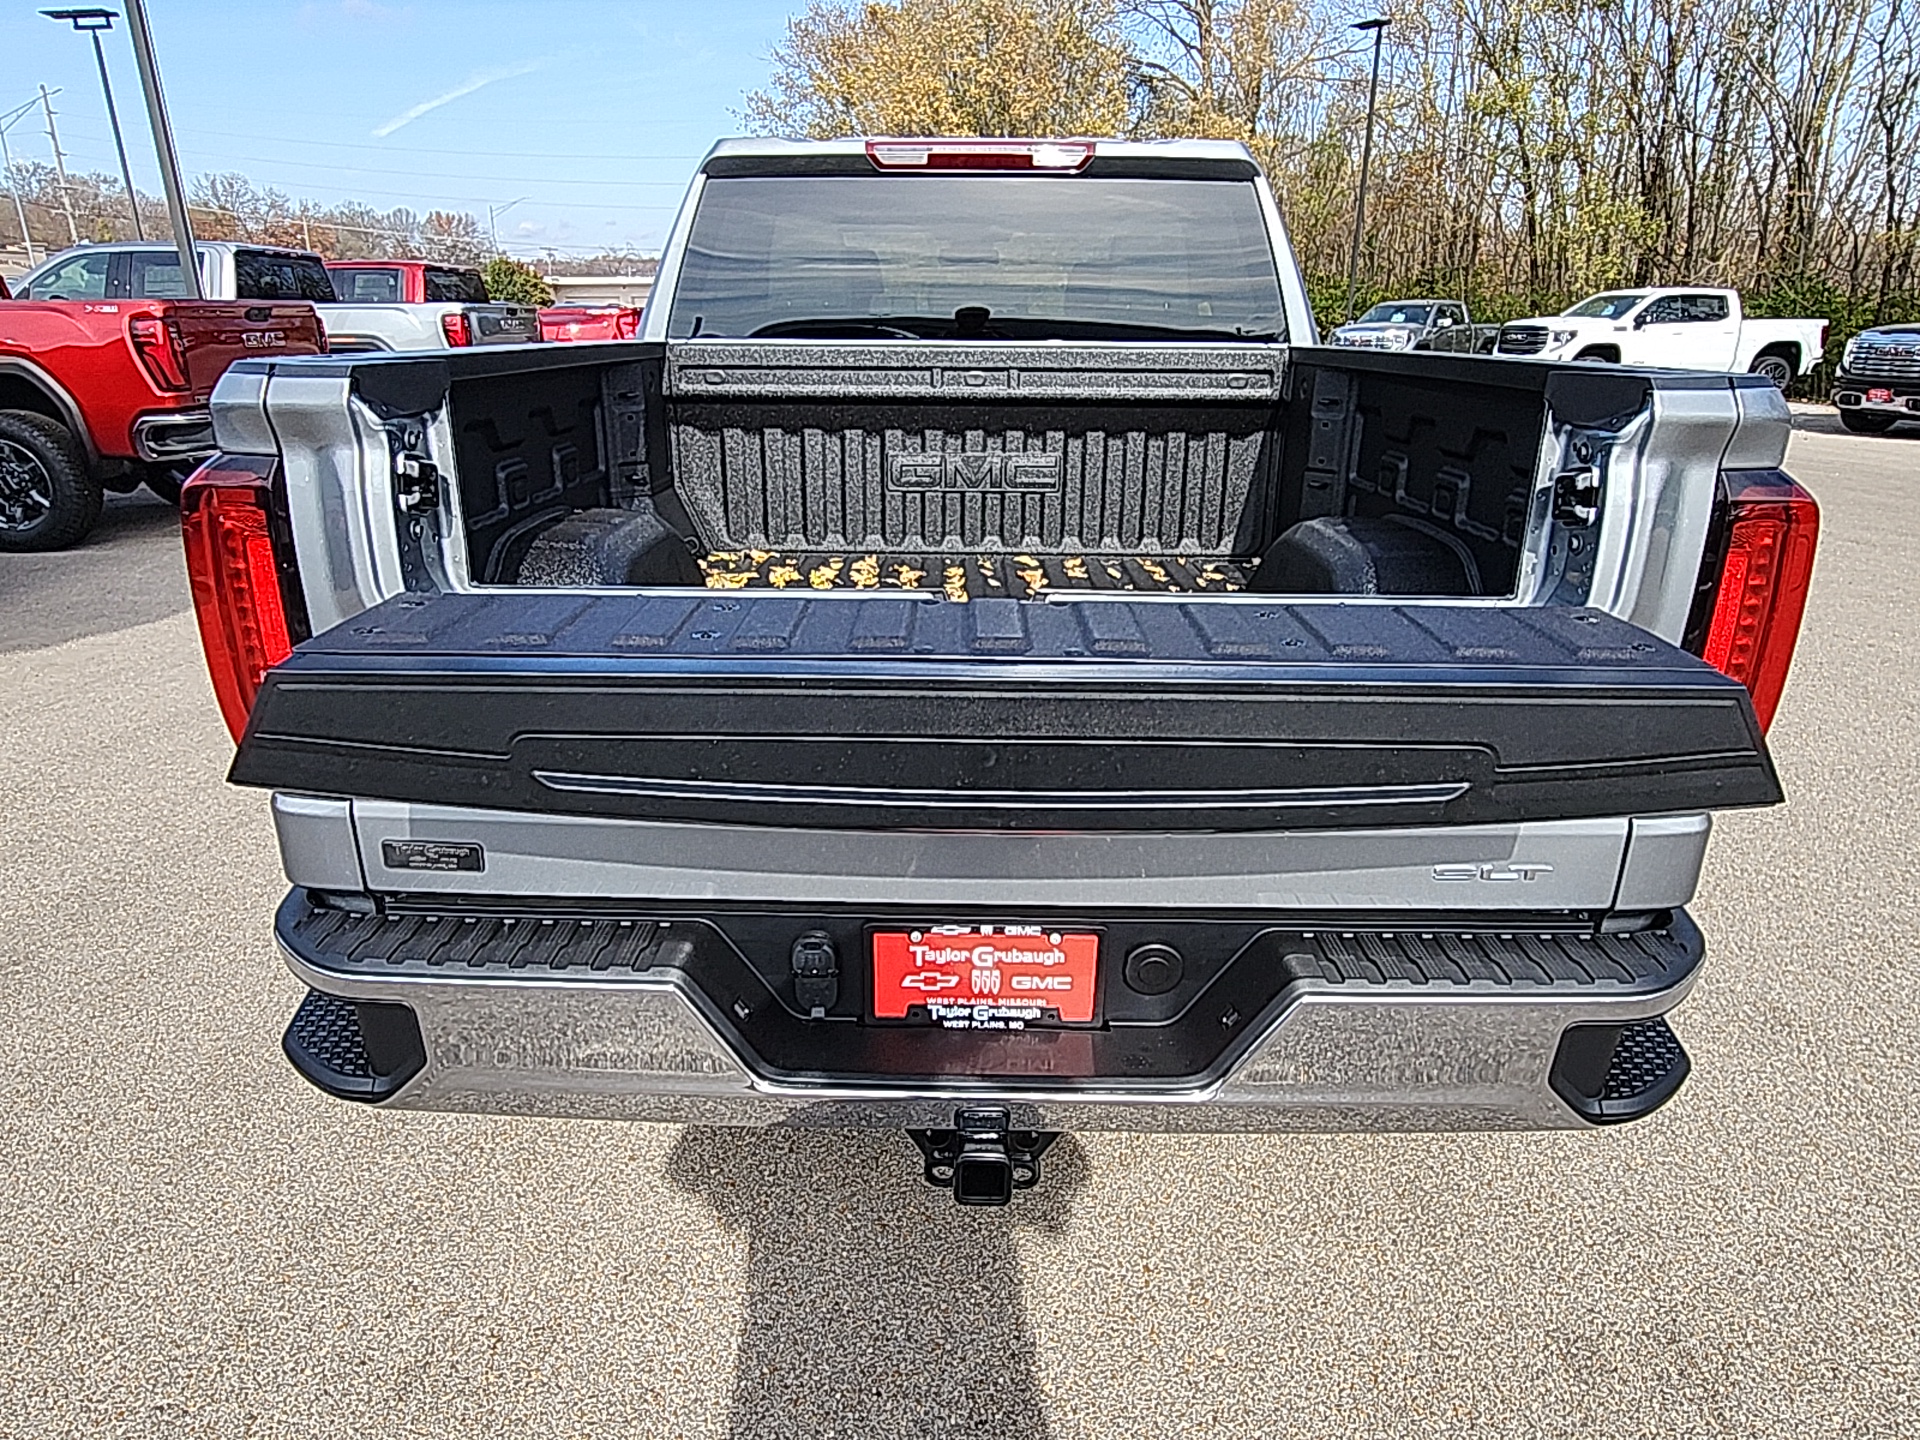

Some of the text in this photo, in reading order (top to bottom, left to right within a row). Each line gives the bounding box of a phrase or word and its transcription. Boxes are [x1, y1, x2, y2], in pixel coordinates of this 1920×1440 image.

[242, 331, 287, 348] GMC
[886, 452, 1062, 492] GMC
[1432, 864, 1554, 881] SLT
[1004, 925, 1042, 936] GMC
[909, 945, 1065, 967] Taylor Grubaugh
[1011, 976, 1073, 990] GMC
[926, 997, 956, 1005] WEST
[998, 998, 1047, 1007] MISSOURI
[927, 1005, 1041, 1021] Taylor Grubaugh
[942, 1020, 970, 1029] WEST
[1008, 1021, 1025, 1030] MO
